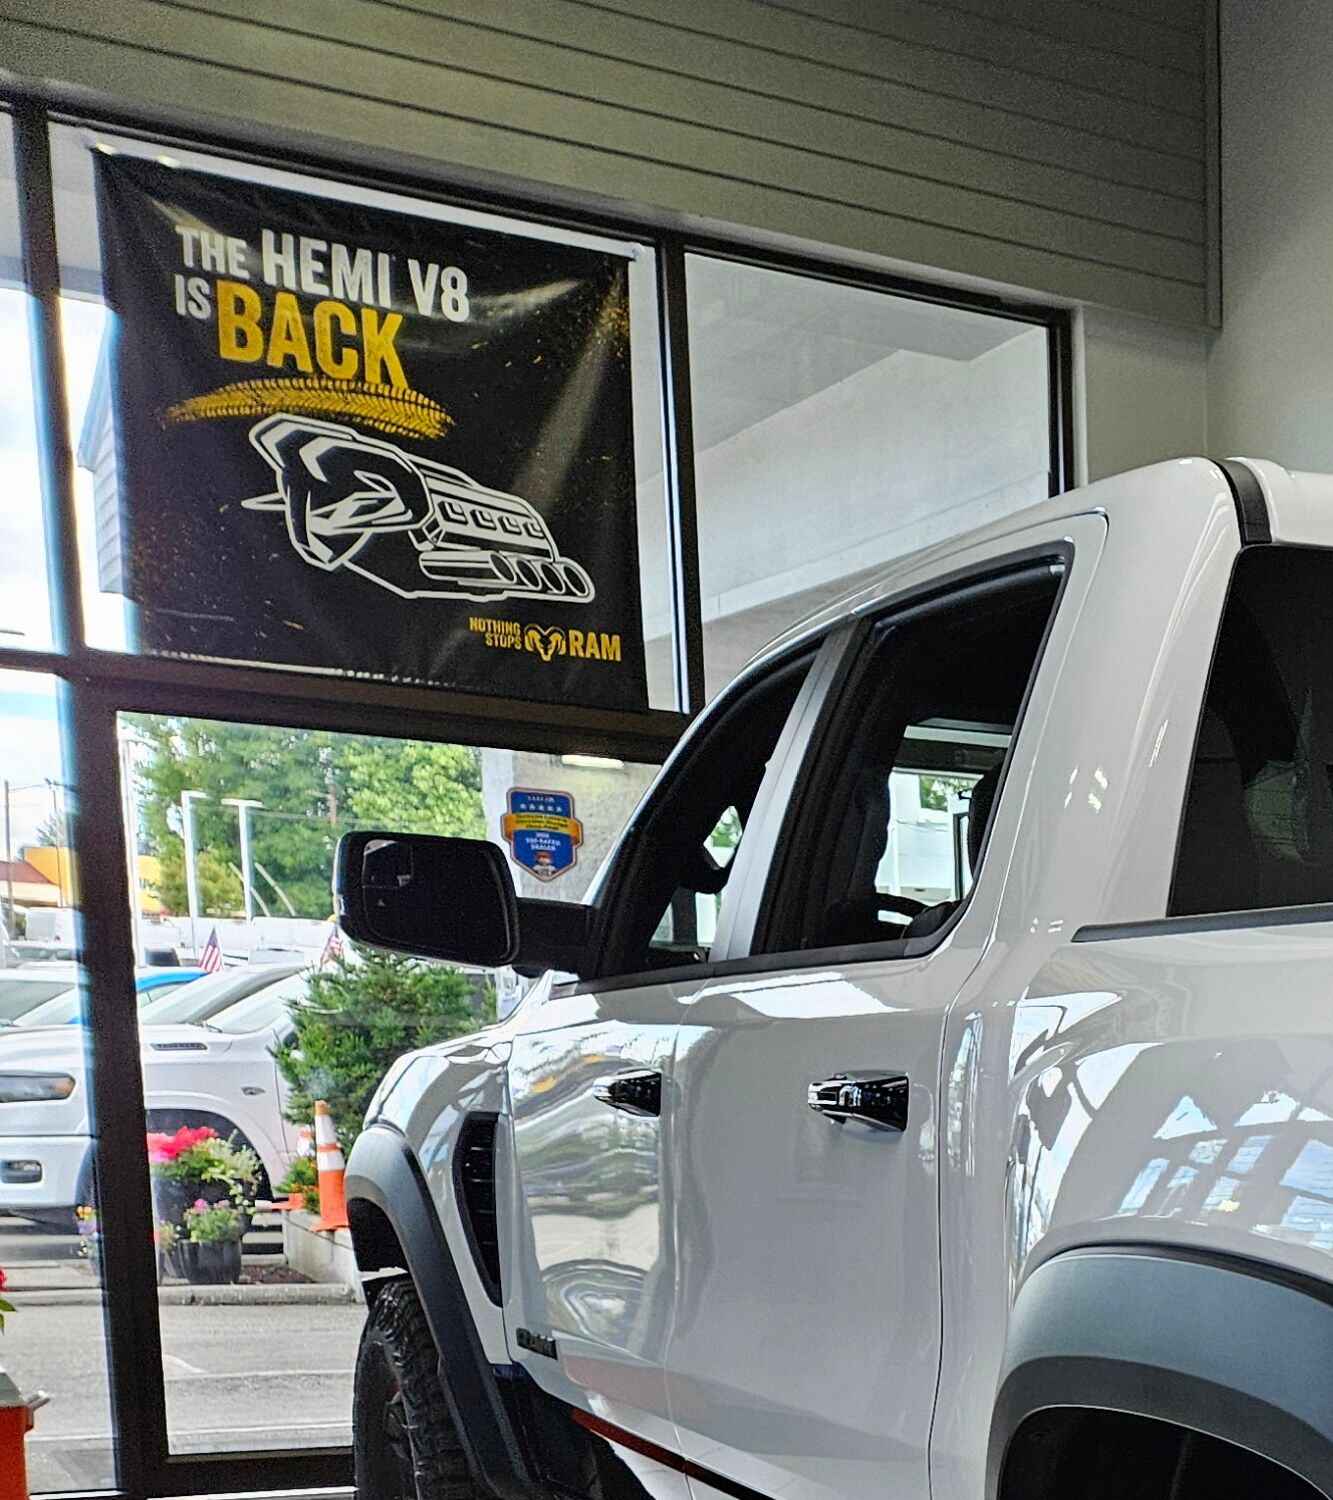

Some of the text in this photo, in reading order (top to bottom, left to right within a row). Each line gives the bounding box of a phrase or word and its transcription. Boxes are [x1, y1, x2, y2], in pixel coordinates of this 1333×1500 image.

[174, 224, 470, 323] THE HEMI V8
[174, 273, 409, 391] IS BACK
[468, 616, 521, 636] NOTHING
[485, 632, 523, 650] STOPS
[568, 629, 622, 662] RAM
